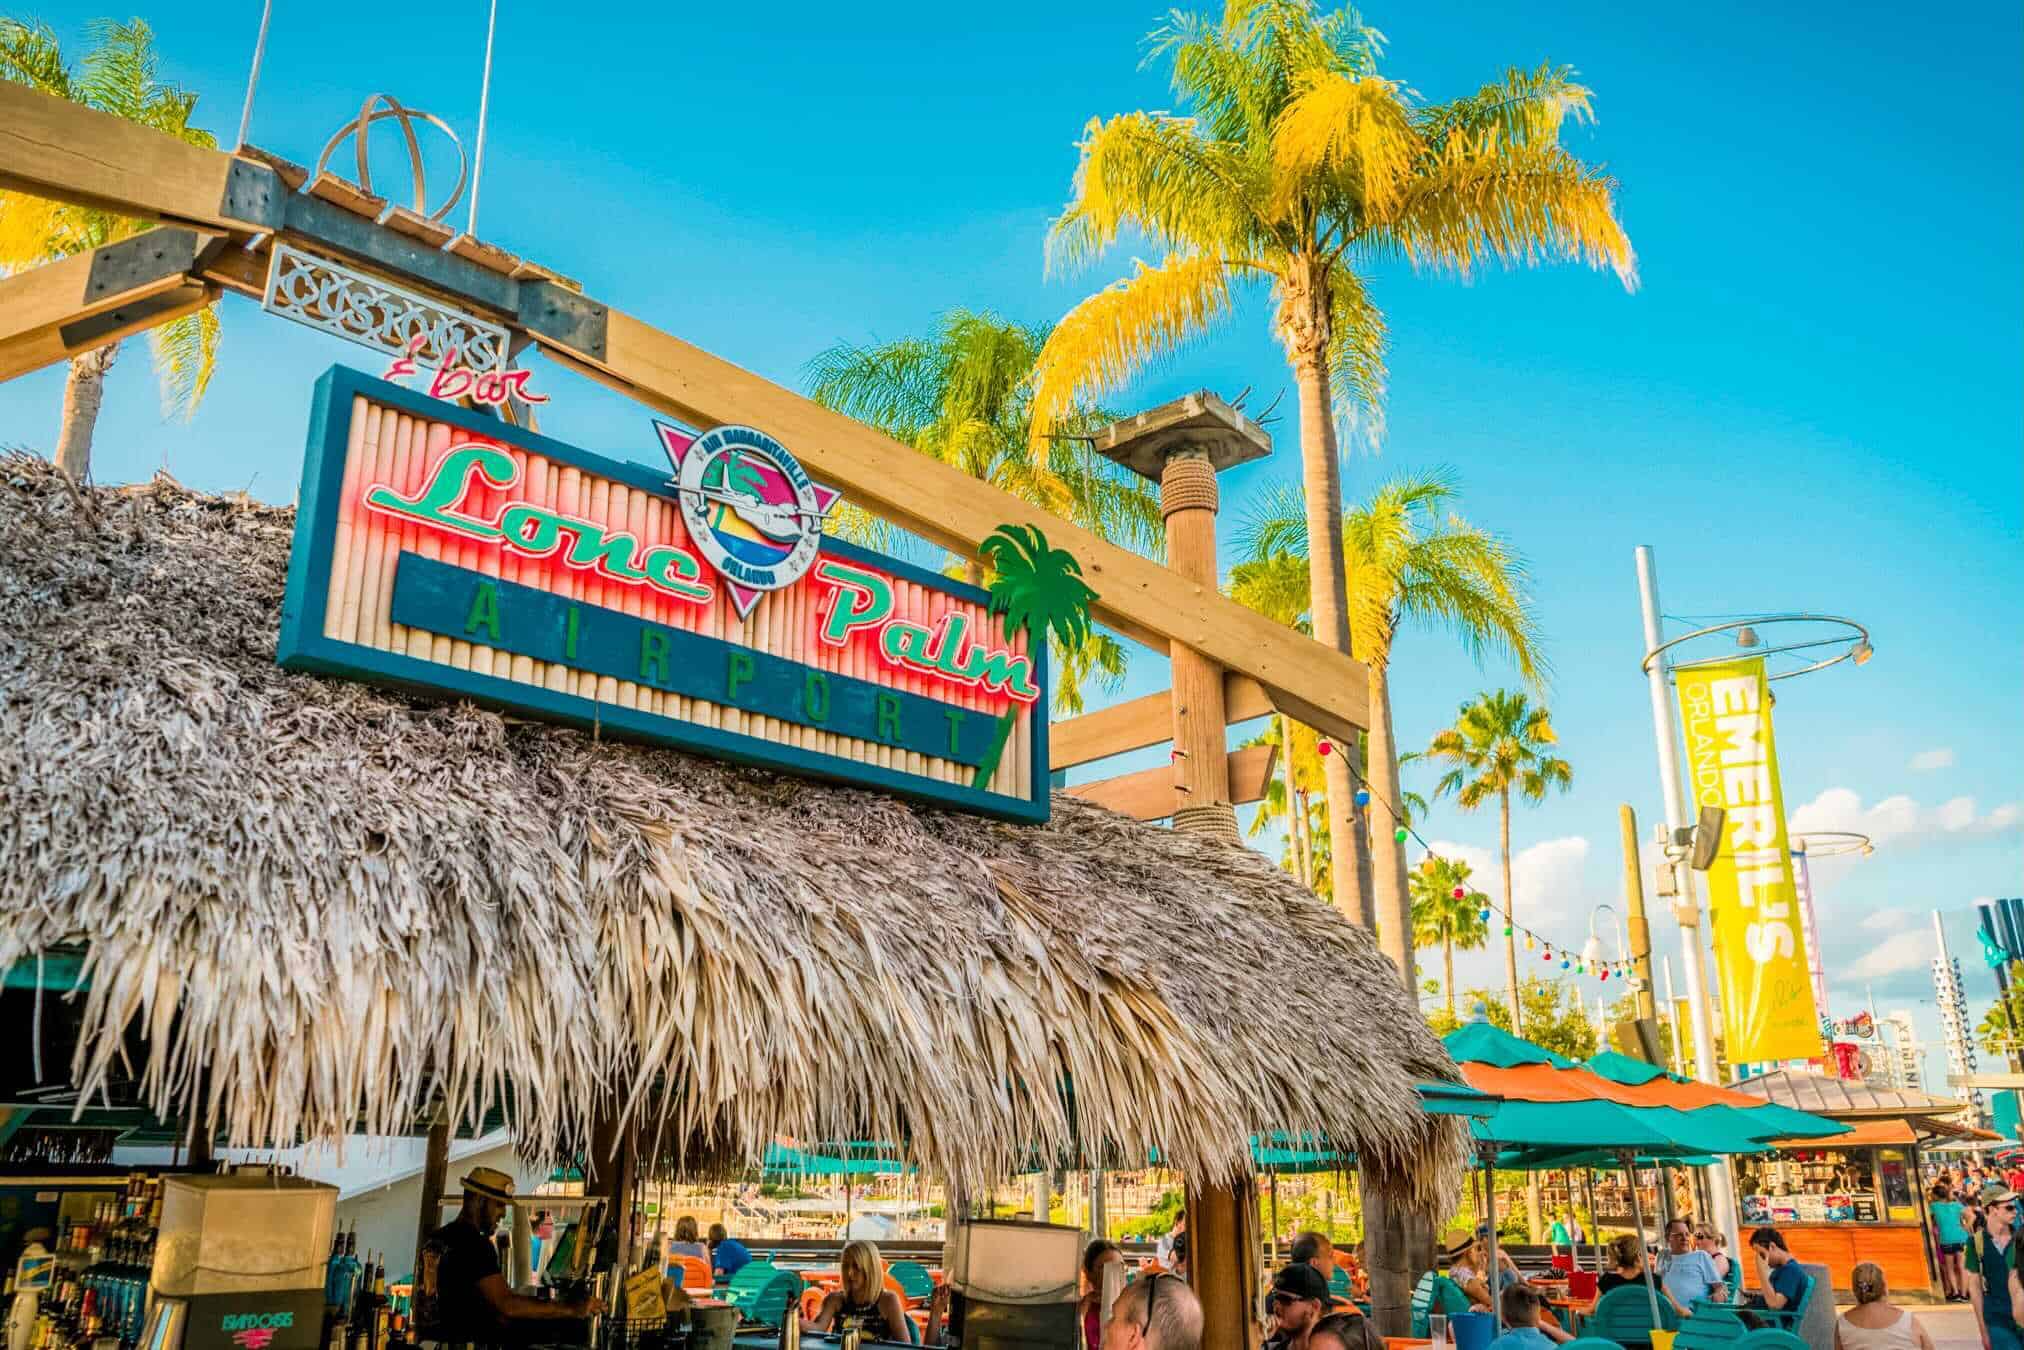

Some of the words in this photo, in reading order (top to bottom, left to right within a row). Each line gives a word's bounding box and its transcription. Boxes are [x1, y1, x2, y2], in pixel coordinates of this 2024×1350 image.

[283, 265, 495, 371] CUSTOMS
[429, 348, 551, 406] bar
[701, 433, 724, 455] AIR
[722, 429, 810, 491] MARGARITAVILLE
[363, 442, 714, 605] Lone
[815, 559, 1040, 702] Palm
[721, 556, 776, 586] ORLANDO
[465, 582, 967, 757] AIRPORT
[1684, 682, 1725, 807] ORLANDO
[1710, 673, 1796, 965] EMERIL'S
